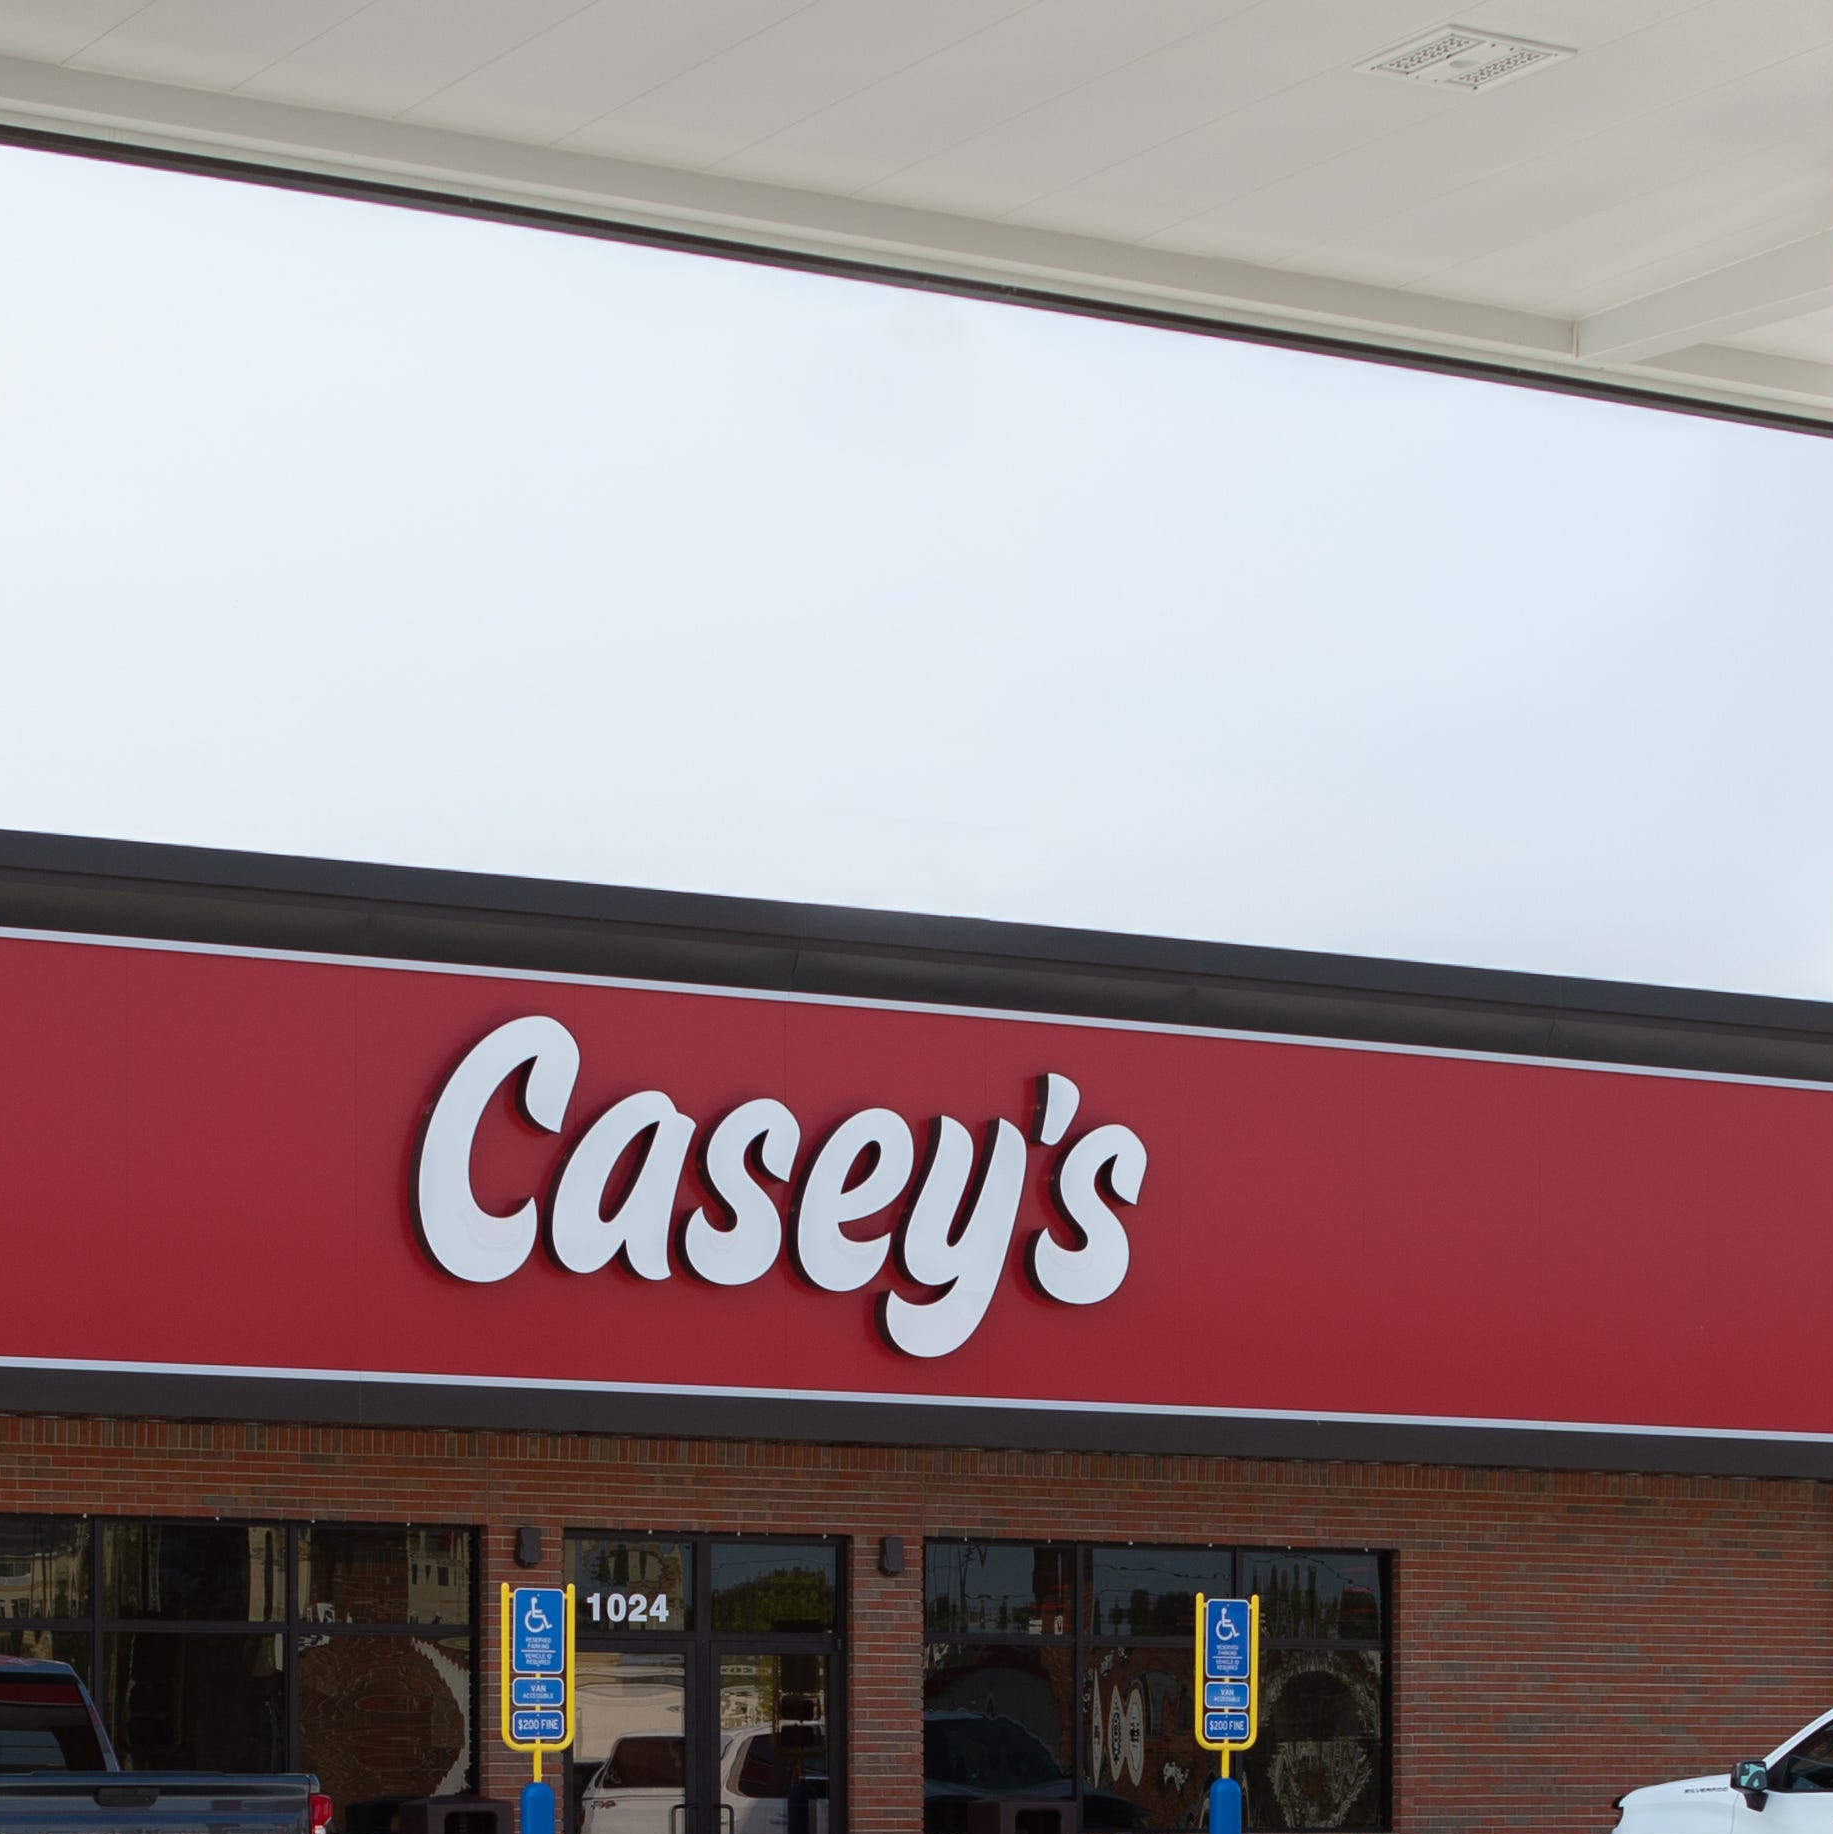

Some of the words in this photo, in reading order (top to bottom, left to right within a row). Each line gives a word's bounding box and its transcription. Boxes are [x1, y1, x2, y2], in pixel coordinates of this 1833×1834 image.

[409, 1015, 1148, 1358] Casey's
[586, 1592, 670, 1622] 1024
[530, 1684, 547, 1692] VAN
[1220, 1688, 1235, 1696] VAN
[518, 1719, 540, 1731] $200
[541, 1719, 559, 1730] FINE
[1209, 1720, 1228, 1731] $200
[1229, 1720, 1245, 1731] FINE
